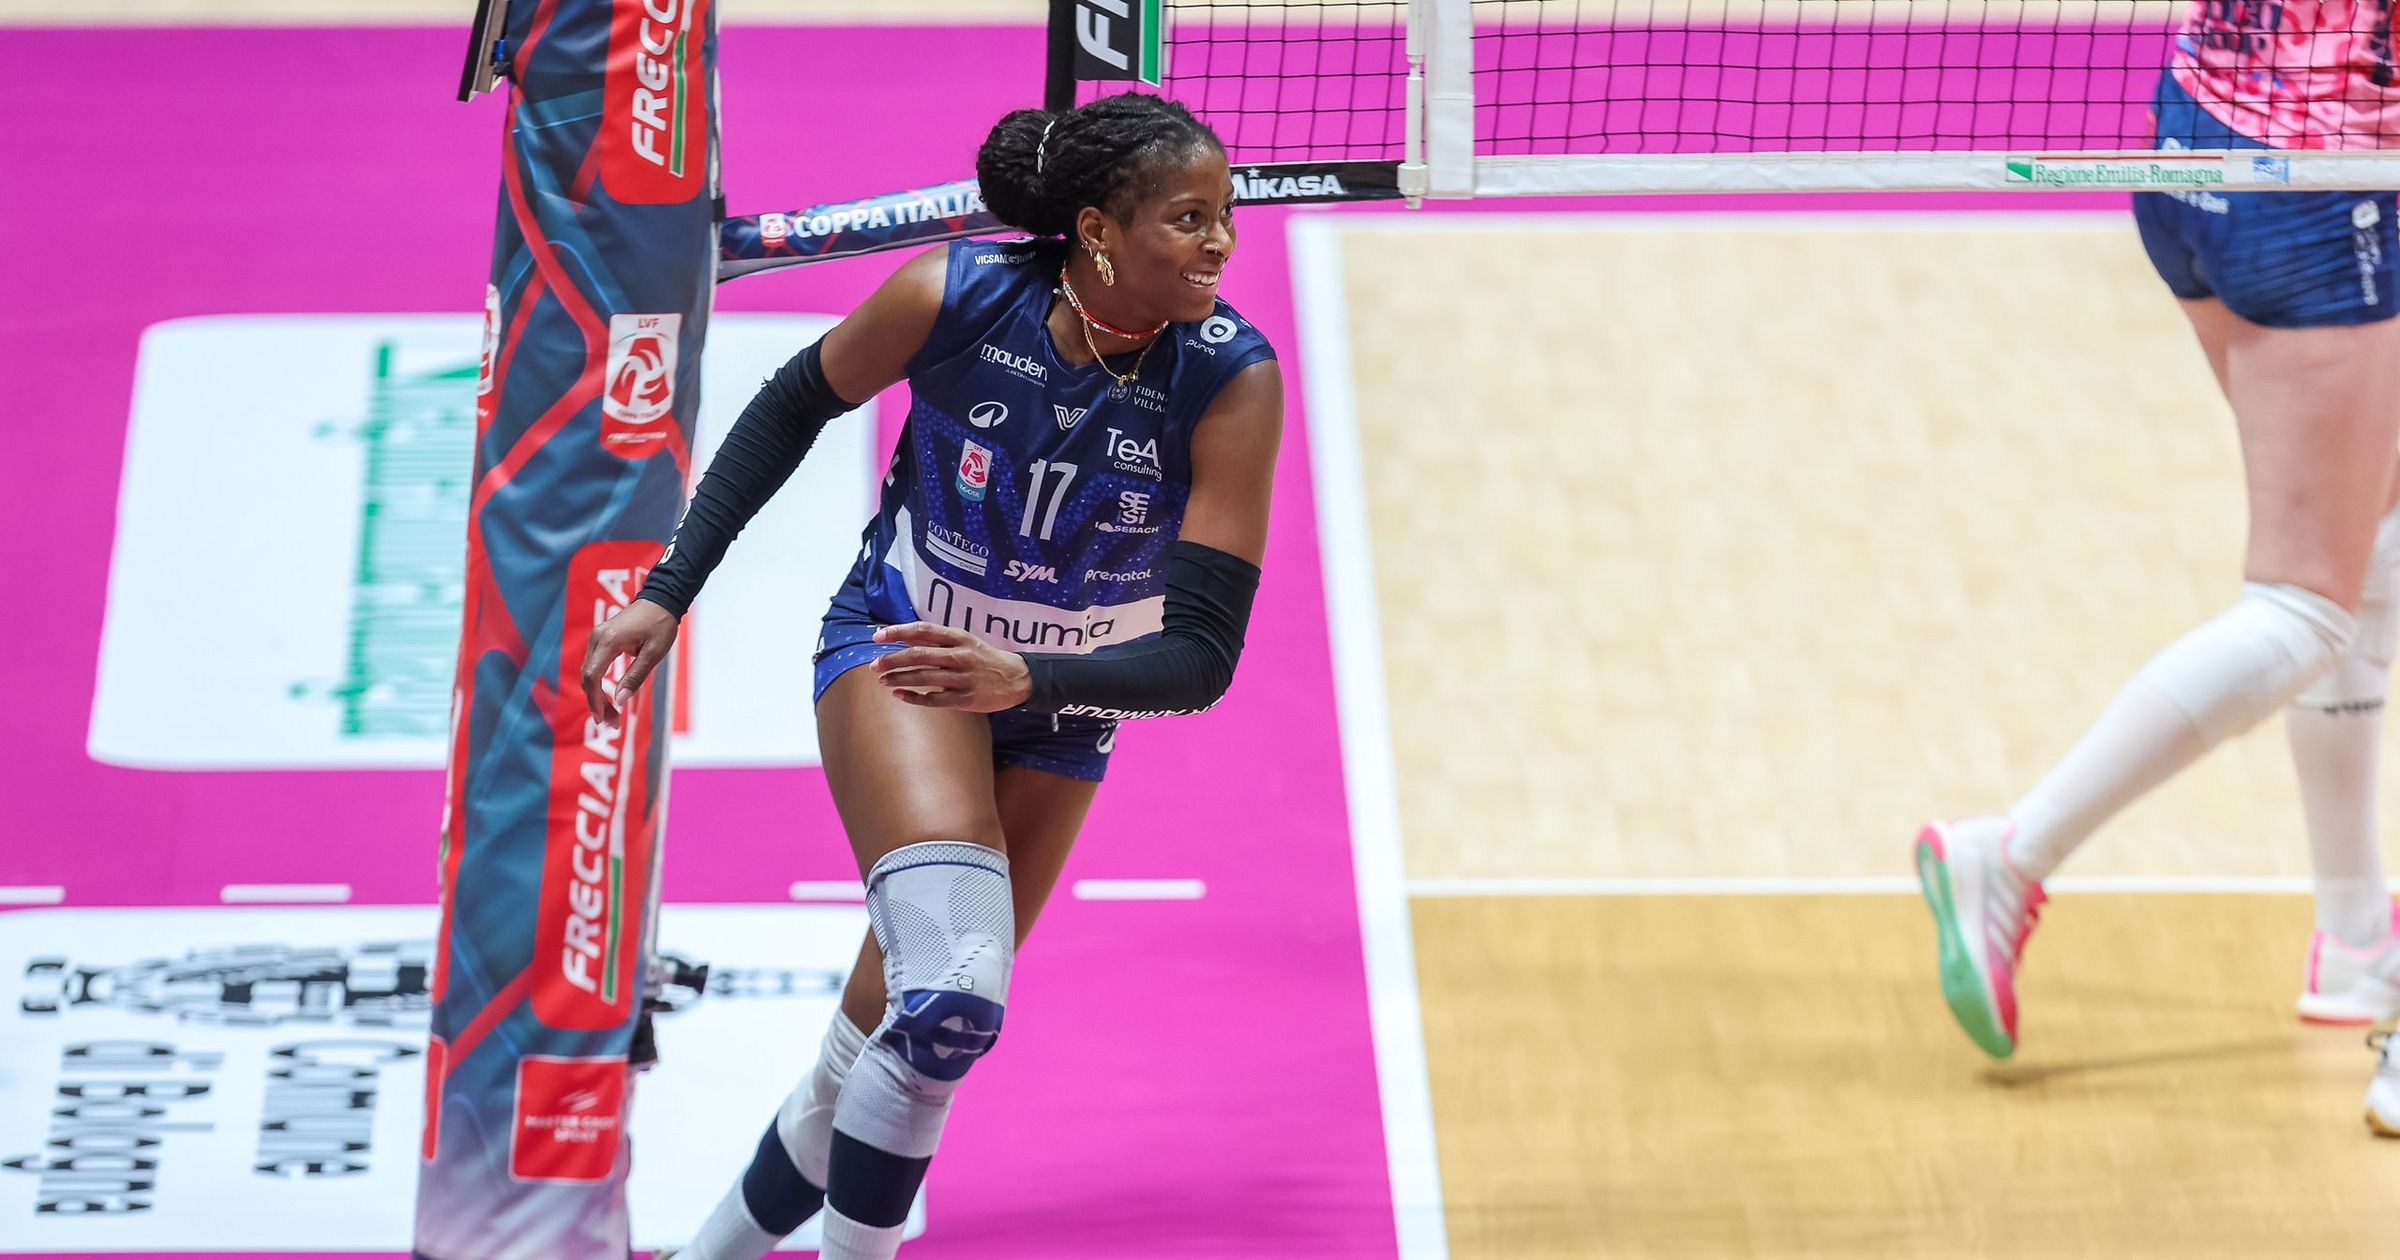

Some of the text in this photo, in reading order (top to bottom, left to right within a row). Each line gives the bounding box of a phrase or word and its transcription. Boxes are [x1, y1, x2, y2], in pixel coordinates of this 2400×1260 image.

[2035, 164, 2223, 186] Regione Emilia-Romagna
[794, 192, 987, 238] COPPA ITALIA
[638, 318, 659, 328] LVF
[981, 343, 1047, 381] mauden
[1114, 461, 1162, 482] consulting
[1020, 458, 1078, 541] 17
[928, 520, 989, 557] CONTECO
[1114, 526, 1159, 534] SEBACH
[1003, 560, 1059, 584] SYM
[1084, 569, 1152, 583] prenatal
[985, 612, 1115, 647] numia
[255, 1038, 421, 1180] Comune
[1, 1080, 215, 1218] Bologna
